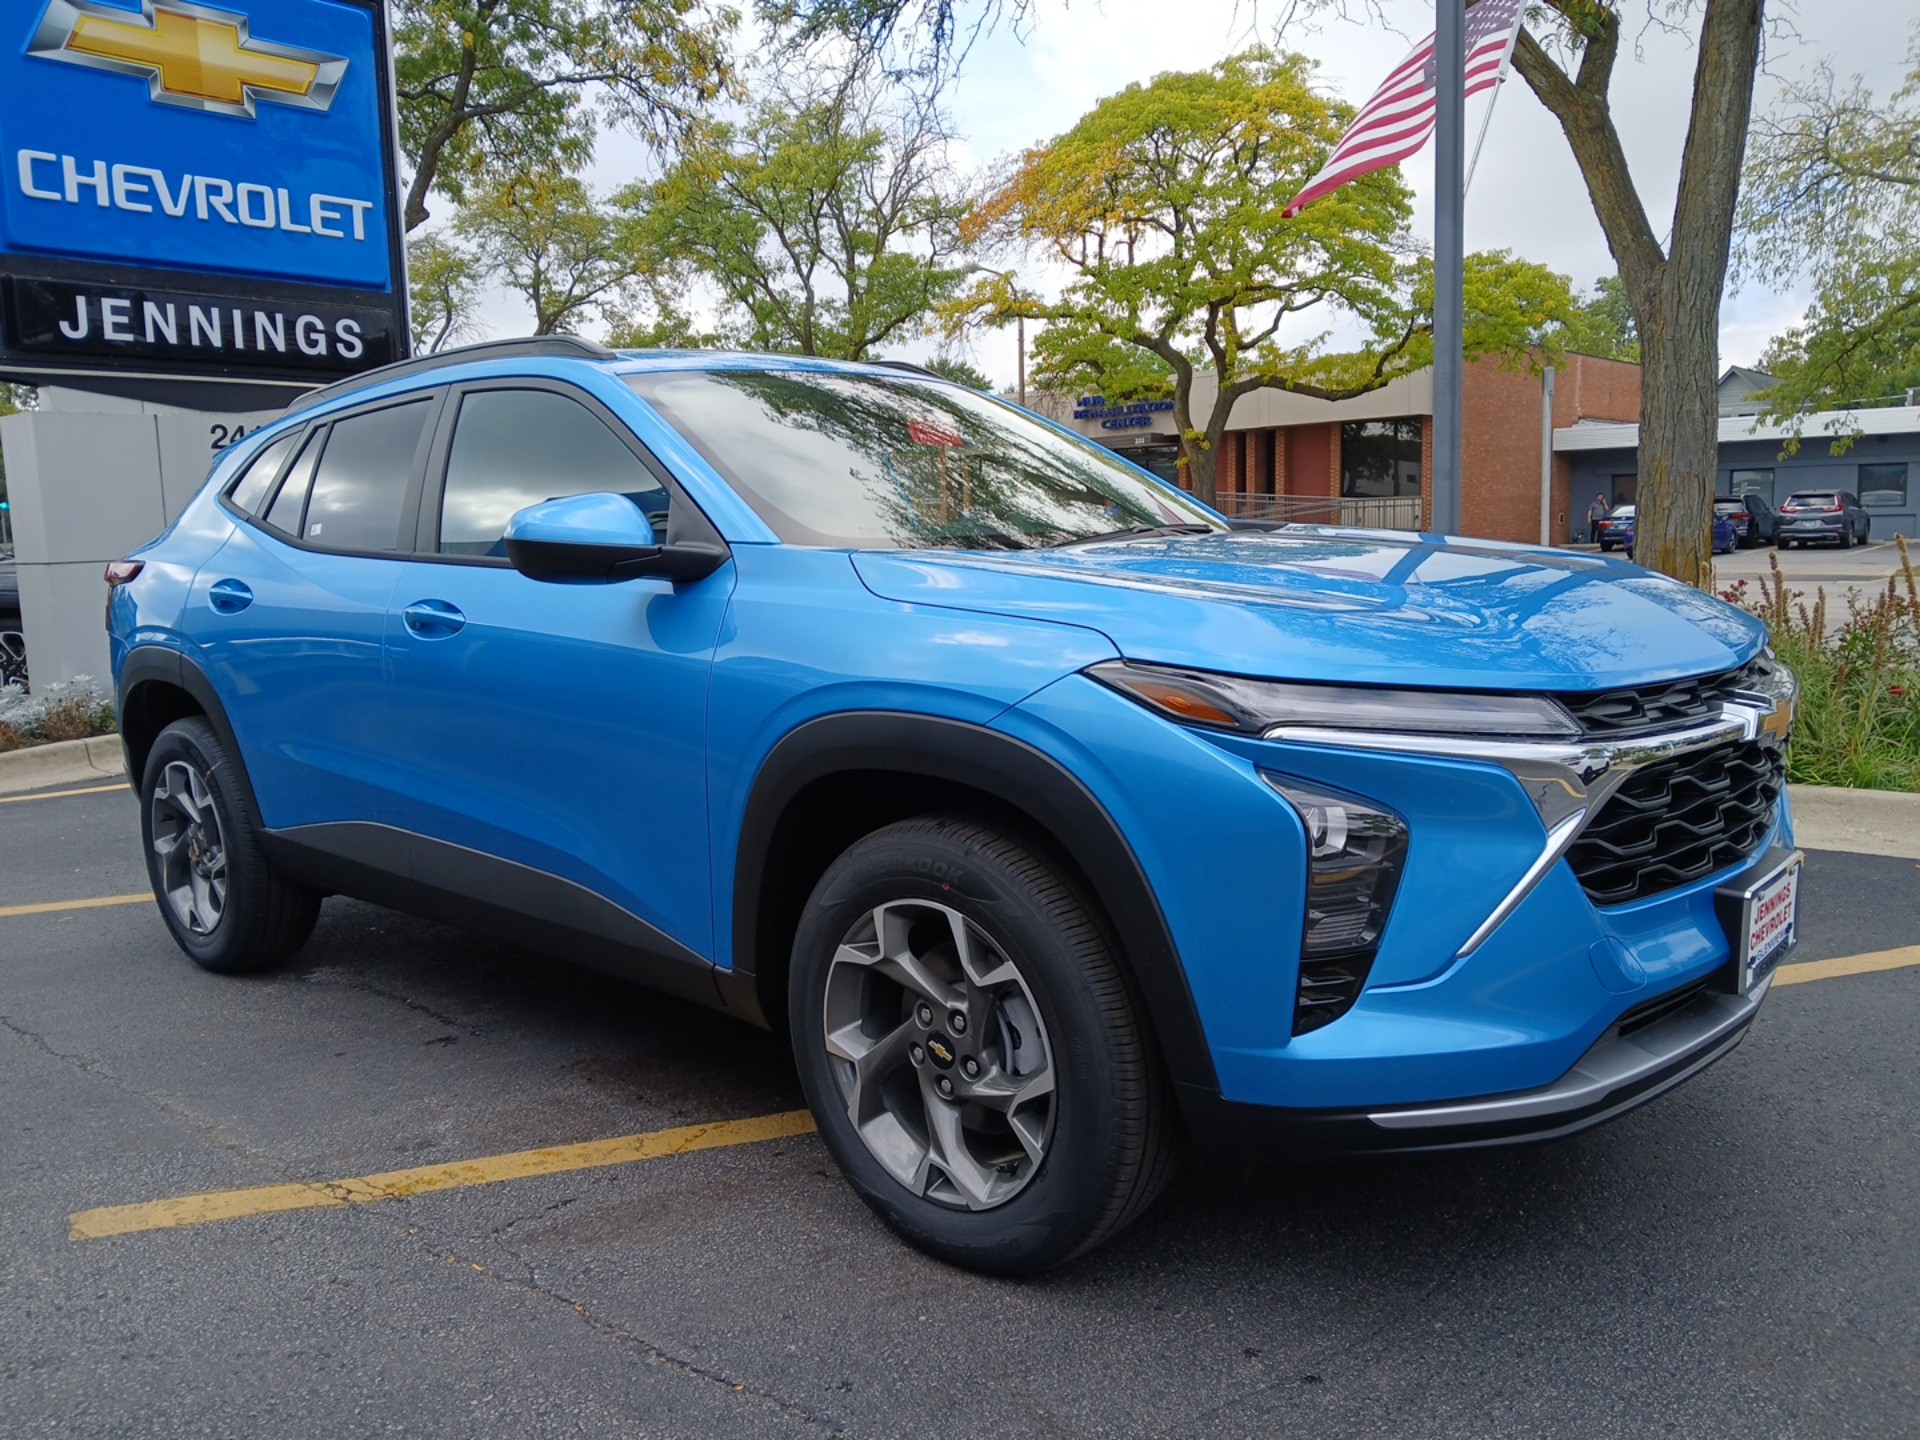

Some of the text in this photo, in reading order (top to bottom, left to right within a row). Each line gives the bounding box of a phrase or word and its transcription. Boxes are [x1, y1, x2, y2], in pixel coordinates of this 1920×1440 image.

[17, 149, 373, 241] CHEVROLET
[58, 294, 364, 359] JENNINGS
[210, 423, 262, 450] 24
[1102, 417, 1152, 430] CENTER
[1751, 902, 1792, 951] CHEVROLET
[1755, 882, 1791, 925] JENNINGS
